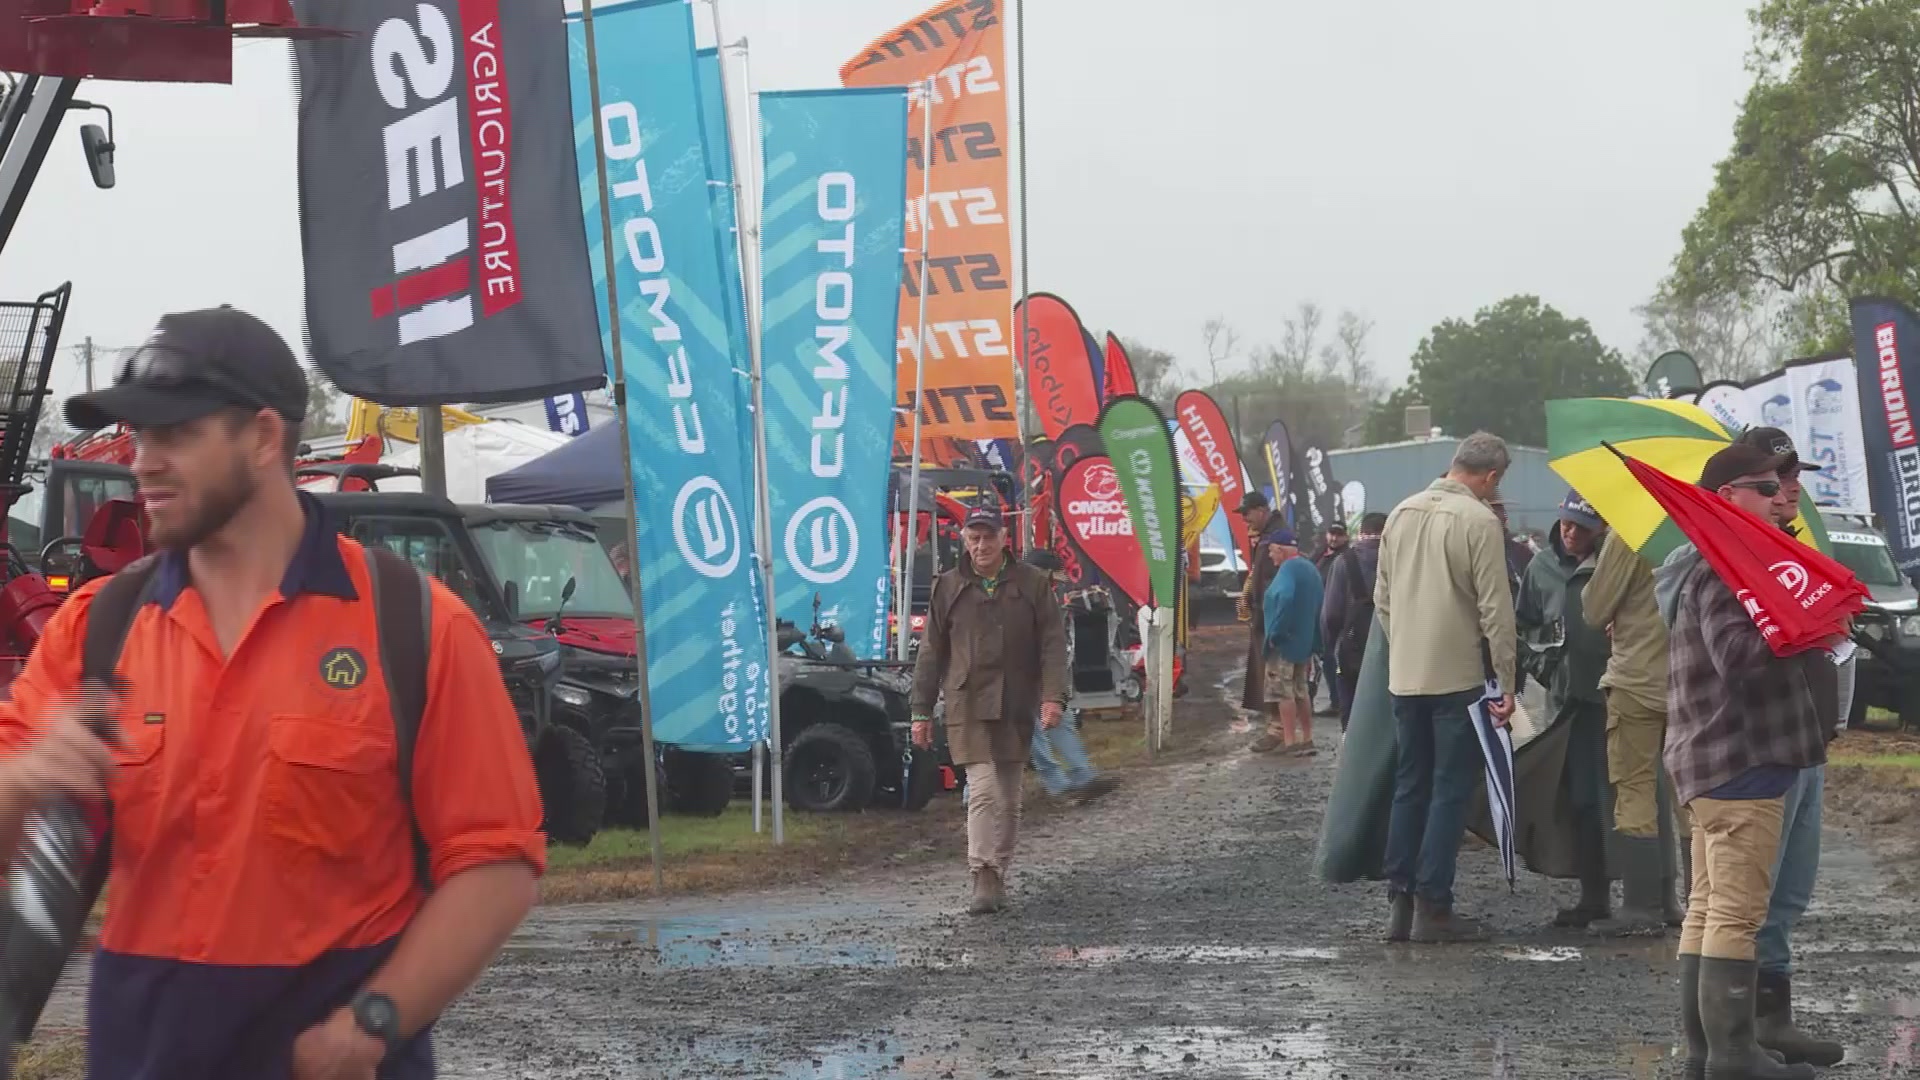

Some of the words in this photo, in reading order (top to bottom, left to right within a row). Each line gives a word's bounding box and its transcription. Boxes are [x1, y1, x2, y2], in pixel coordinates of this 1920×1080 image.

[1876, 327, 1913, 443] BORDIN
[1182, 404, 1237, 493] HITACHI
[1134, 478, 1166, 562] KRONE
